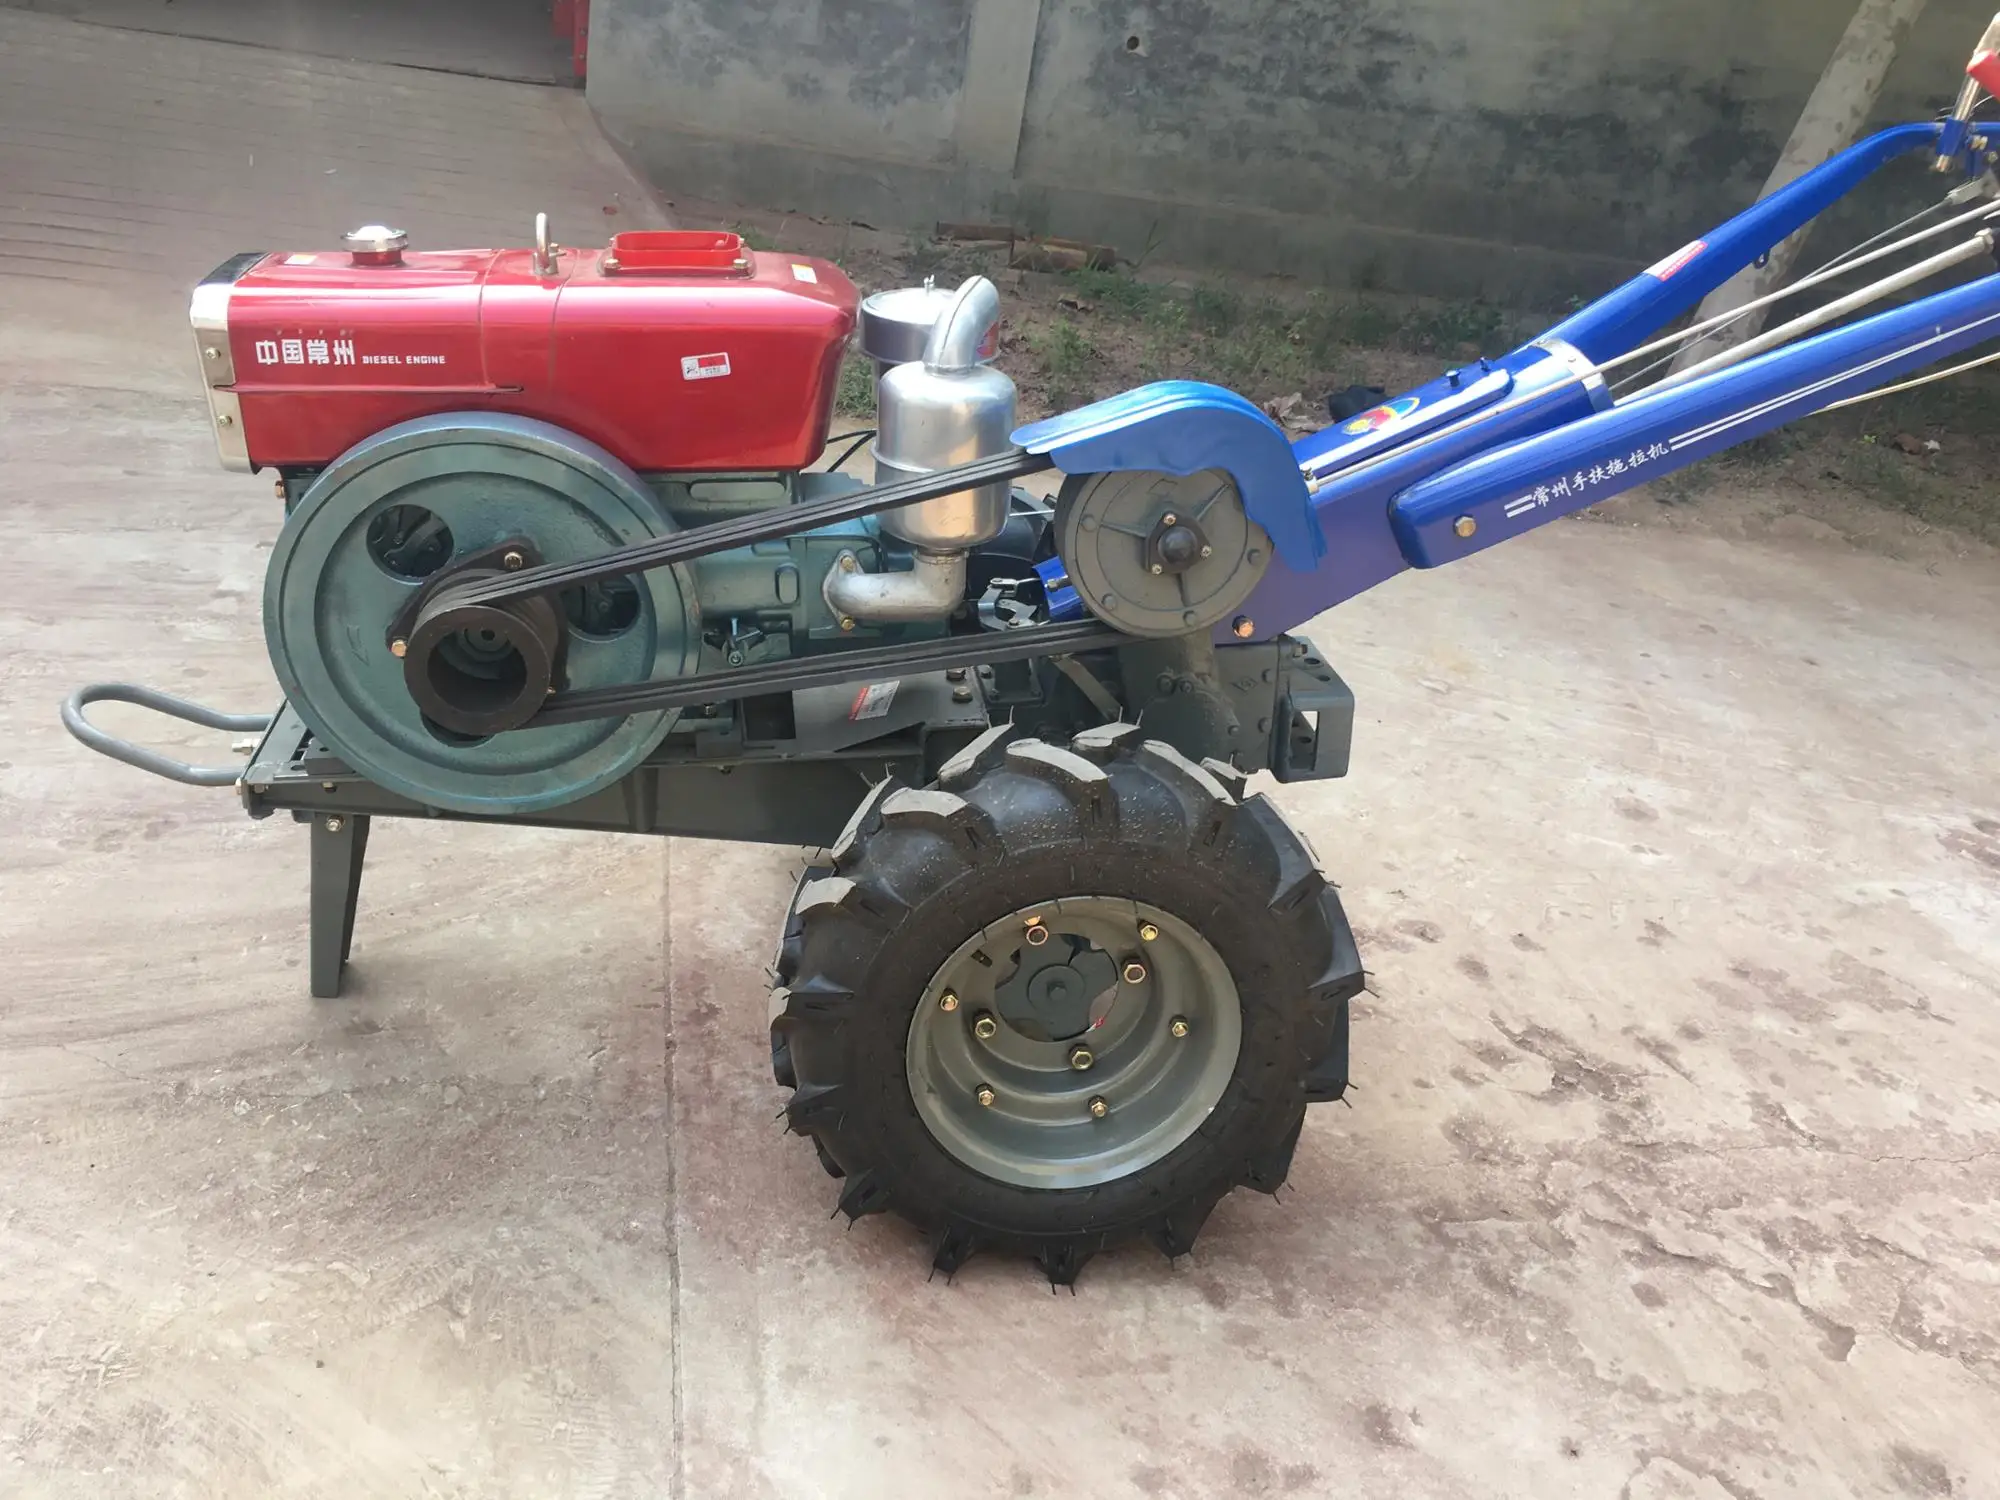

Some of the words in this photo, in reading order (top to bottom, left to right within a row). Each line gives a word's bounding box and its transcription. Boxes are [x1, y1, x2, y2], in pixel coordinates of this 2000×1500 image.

[255, 338, 356, 366] 中国常州
[362, 355, 402, 365] DIESEL
[406, 355, 446, 365] ENGINE
[1532, 442, 1669, 508] 常州手扶拖拉机
